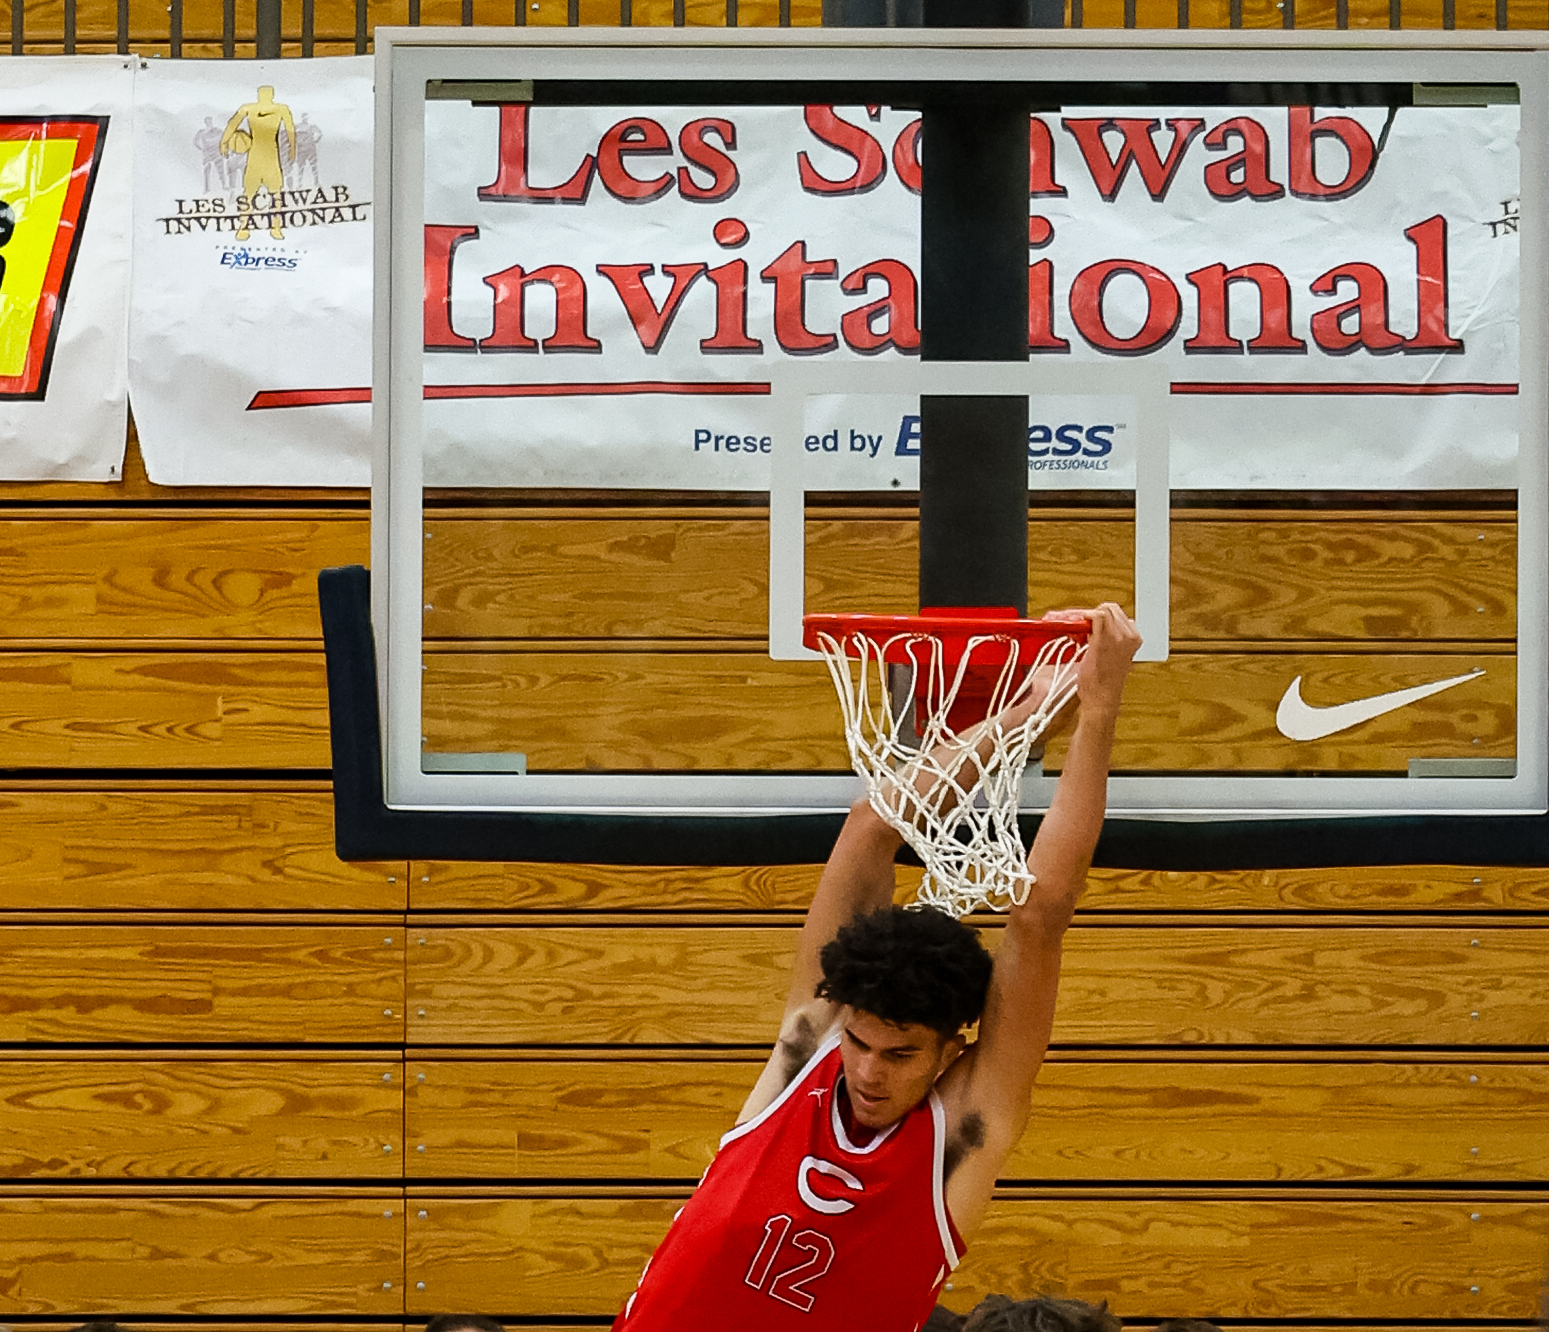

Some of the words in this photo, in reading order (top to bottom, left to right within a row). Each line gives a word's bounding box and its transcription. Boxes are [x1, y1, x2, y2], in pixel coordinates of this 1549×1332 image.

[477, 104, 740, 206] Les
[163, 204, 367, 236] INVITATIONAL
[175, 198, 226, 216] LES
[237, 185, 350, 214] SCHWAB
[220, 249, 298, 268] Express
[424, 215, 1465, 356] Invitaional
[694, 429, 839, 453] Preseed
[850, 429, 883, 458] by
[894, 415, 1115, 457] Eess
[797, 1155, 863, 1214] C
[744, 1214, 836, 1313] 12
